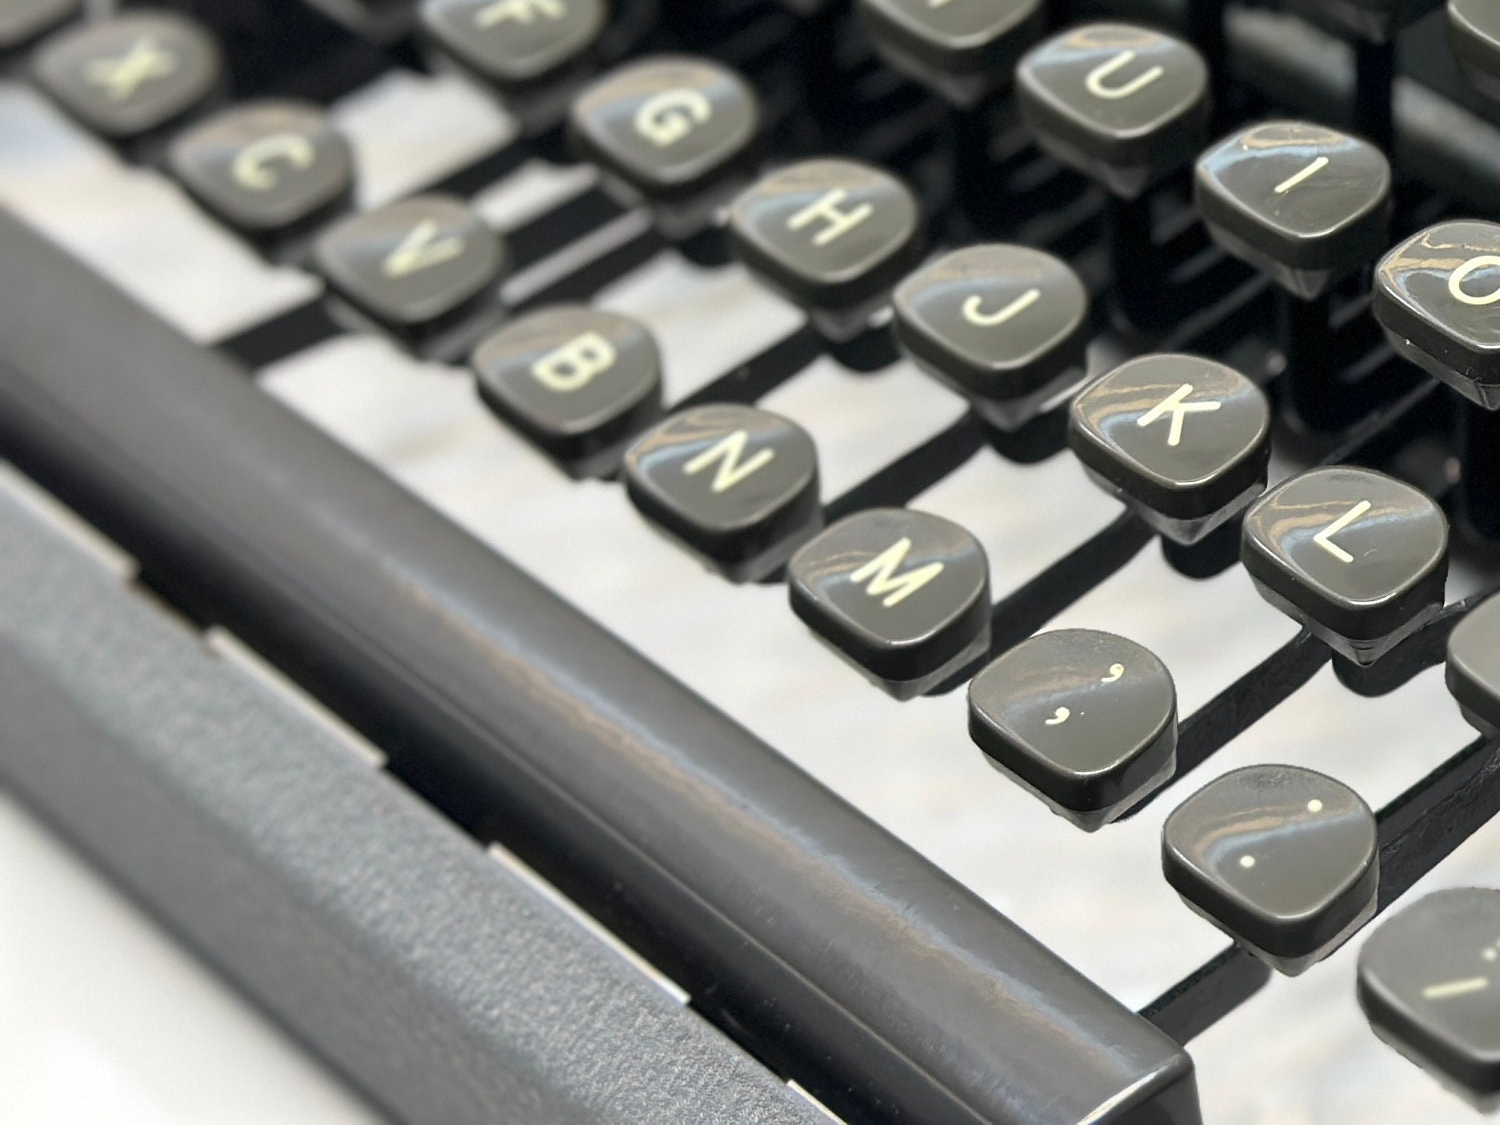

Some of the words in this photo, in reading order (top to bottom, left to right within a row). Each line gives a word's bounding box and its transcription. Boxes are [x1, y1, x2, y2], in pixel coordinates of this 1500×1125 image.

[1086, 49, 1164, 100] U
[636, 88, 711, 147] G
[233, 131, 314, 191] C
[1273, 156, 1329, 194] I
[787, 188, 873, 246] H
[384, 220, 464, 278] V
[961, 288, 1041, 327] J
[529, 330, 617, 393] B
[1136, 382, 1222, 447] K
[684, 429, 774, 493] N
[1312, 500, 1372, 564] L
[849, 536, 944, 608] M
